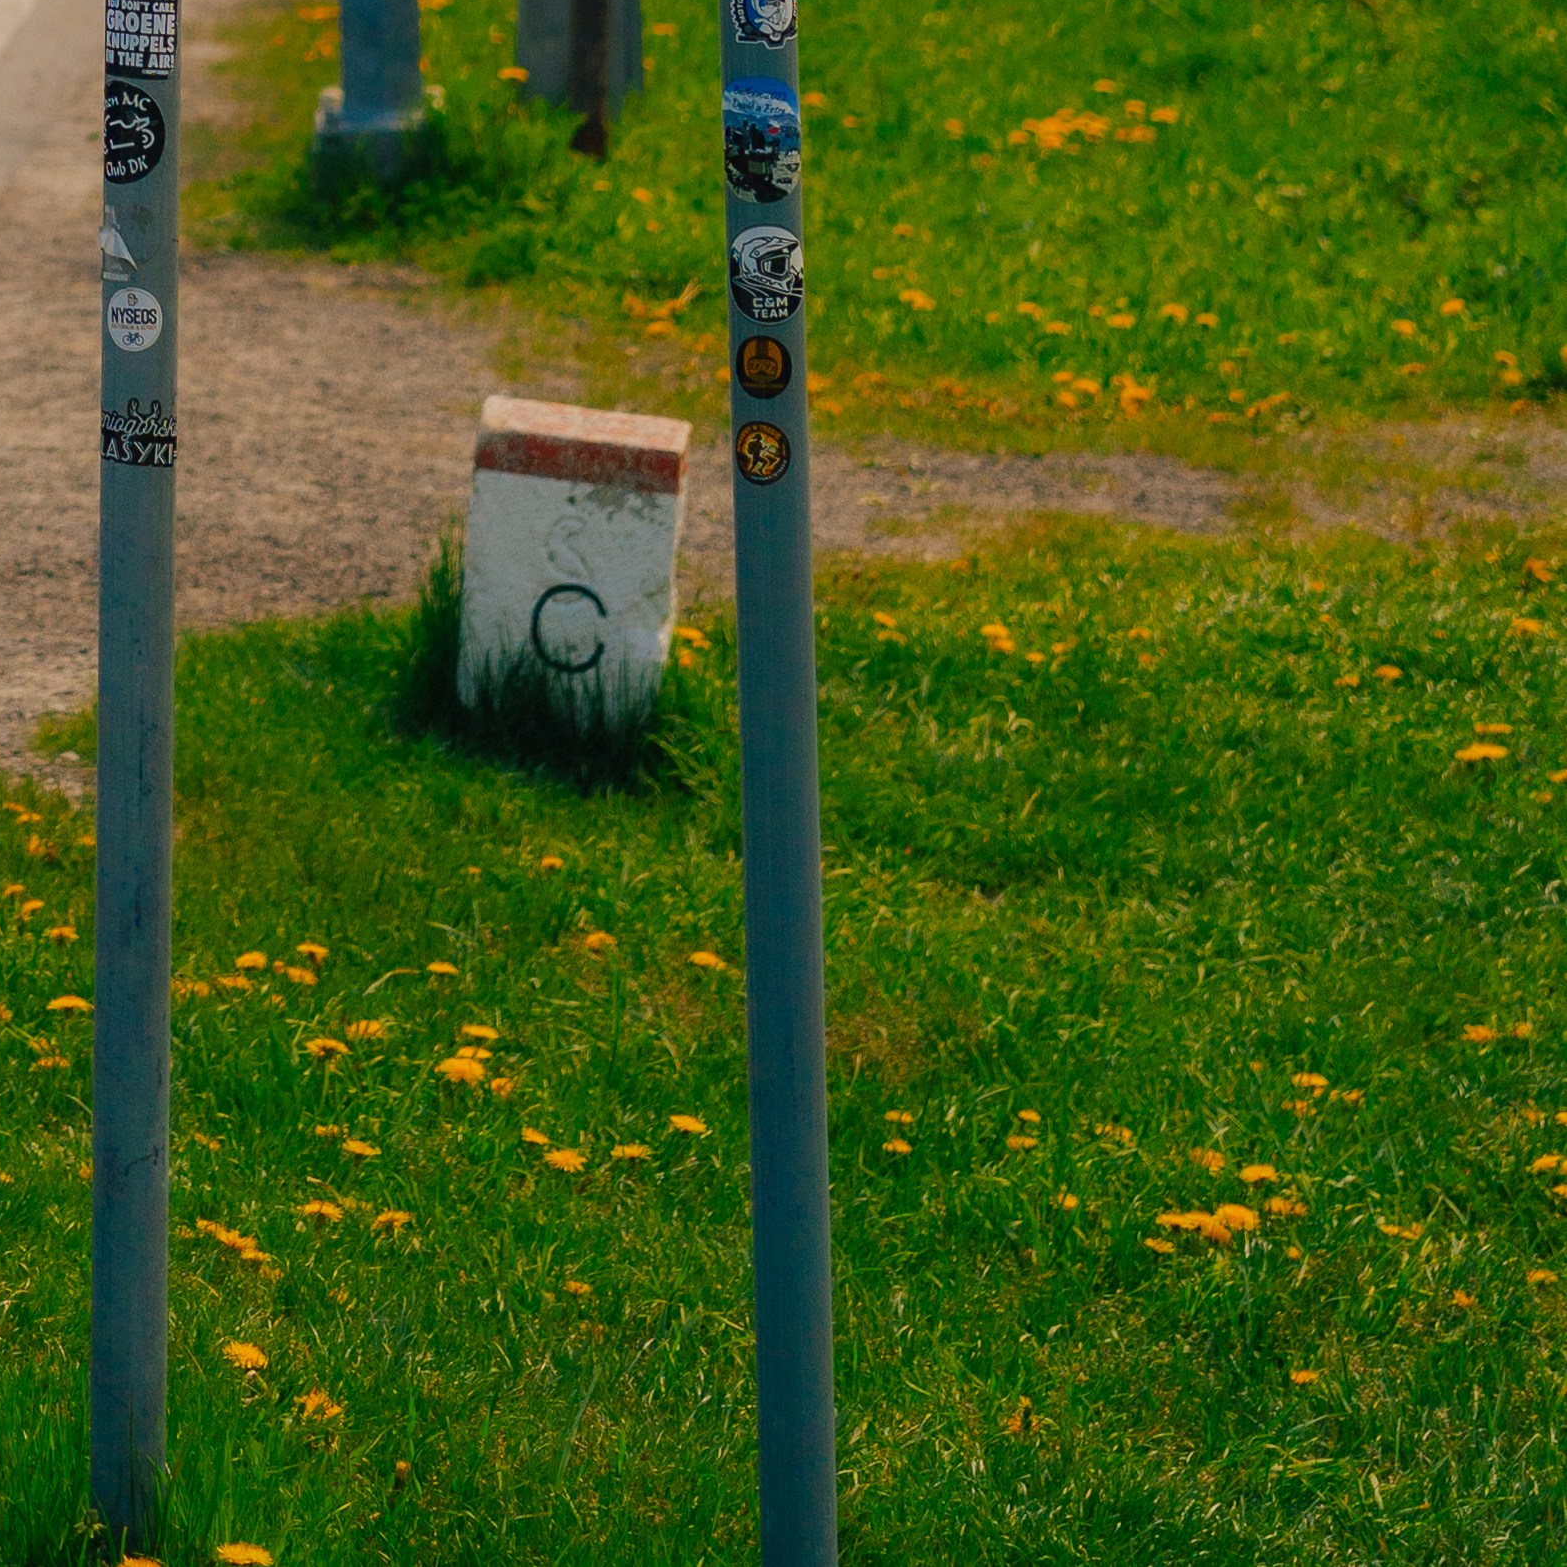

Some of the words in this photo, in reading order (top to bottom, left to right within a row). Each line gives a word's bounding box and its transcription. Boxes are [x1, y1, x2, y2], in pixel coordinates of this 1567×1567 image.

[152, 1, 175, 14] CARE
[107, 12, 175, 35] GROENE
[106, 33, 175, 54] KNUPPELS
[118, 52, 144, 67] THE
[147, 55, 175, 70] AIR!
[123, 91, 151, 111] MC
[128, 155, 148, 173] DK
[753, 296, 789, 308] C&M
[111, 306, 158, 326] NYSEOS
[753, 308, 788, 318] TEAM
[531, 581, 608, 672] C
